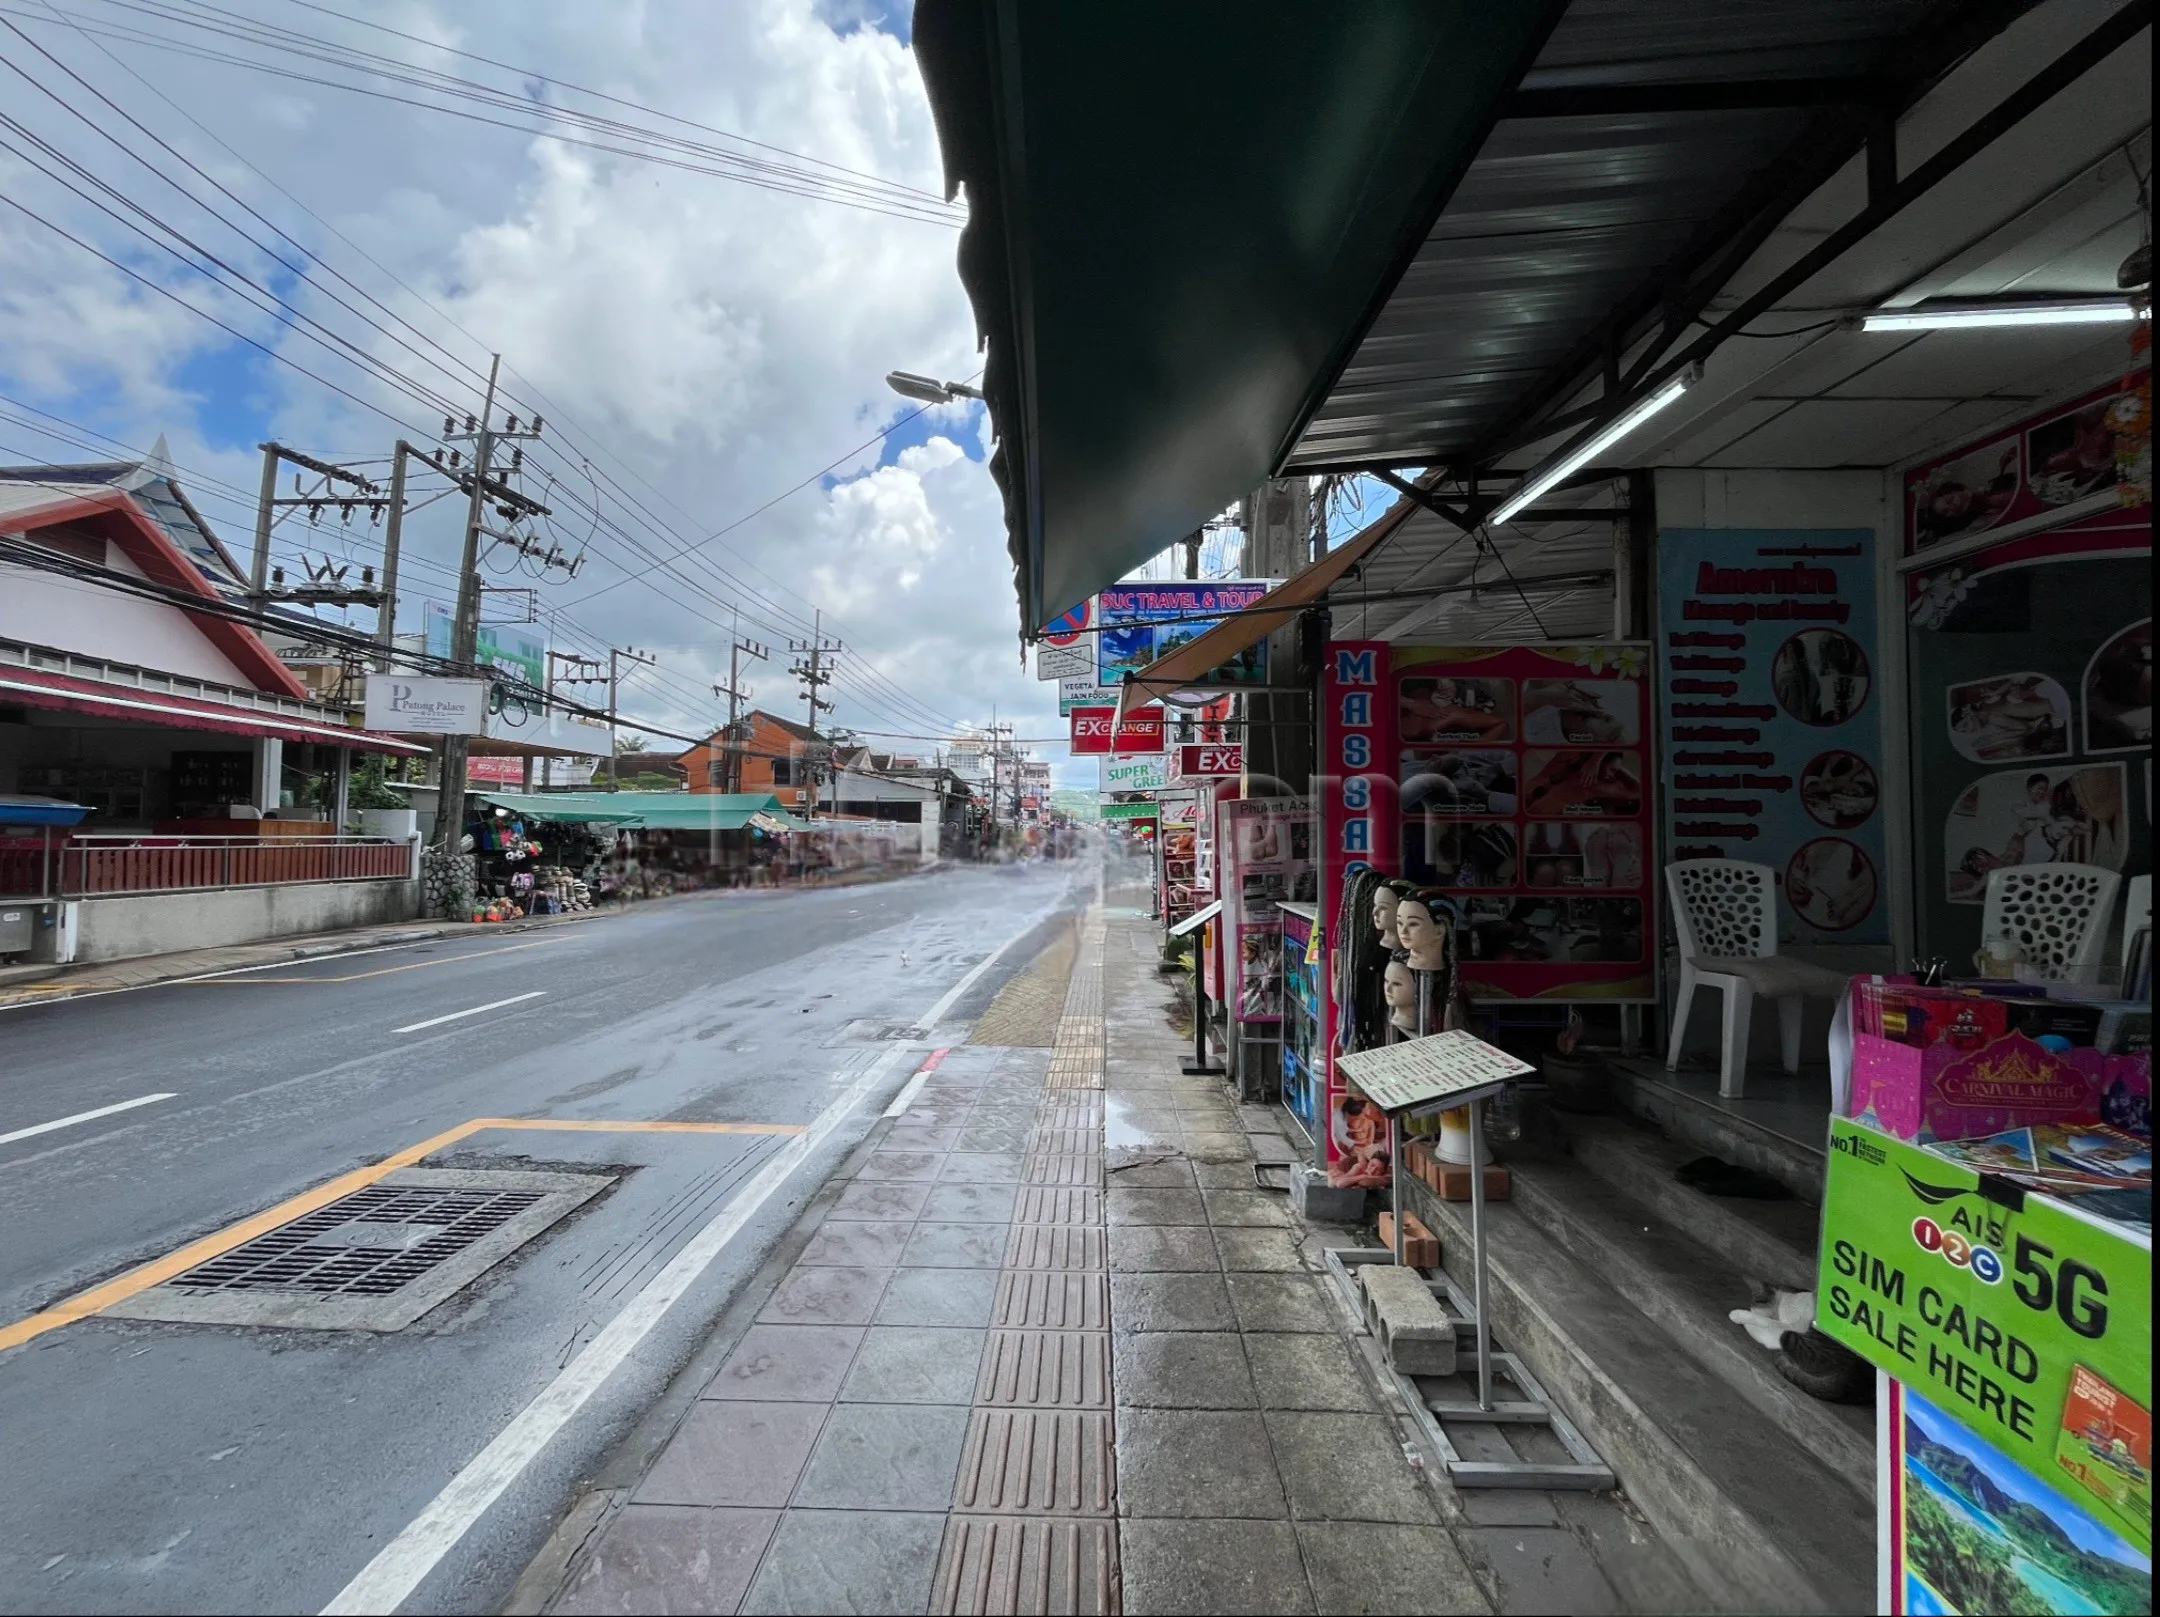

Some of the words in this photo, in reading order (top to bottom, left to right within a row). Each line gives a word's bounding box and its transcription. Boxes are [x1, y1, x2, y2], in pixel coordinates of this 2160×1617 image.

[1101, 591, 1135, 609] BUC
[1137, 591, 1200, 609] TRAVEL
[1202, 591, 1215, 609] &
[402, 700, 434, 712] Patong
[437, 701, 466, 712] Palace
[1075, 721, 1153, 735] EXCANGE
[1108, 765, 1149, 780] SUPER
[1241, 801, 1284, 814] Phuket
[1944, 1078, 2021, 1098] CARNIVAL
[2029, 1082, 2080, 1099] MAGIC
[1950, 1206, 2003, 1247] AIS
[2012, 1232, 2109, 1340] 5G
[1833, 1240, 1905, 1306] SIM
[1918, 1286, 2039, 1384] CARD
[1830, 1285, 1918, 1363] SALE
[1928, 1342, 2036, 1443] HERE
